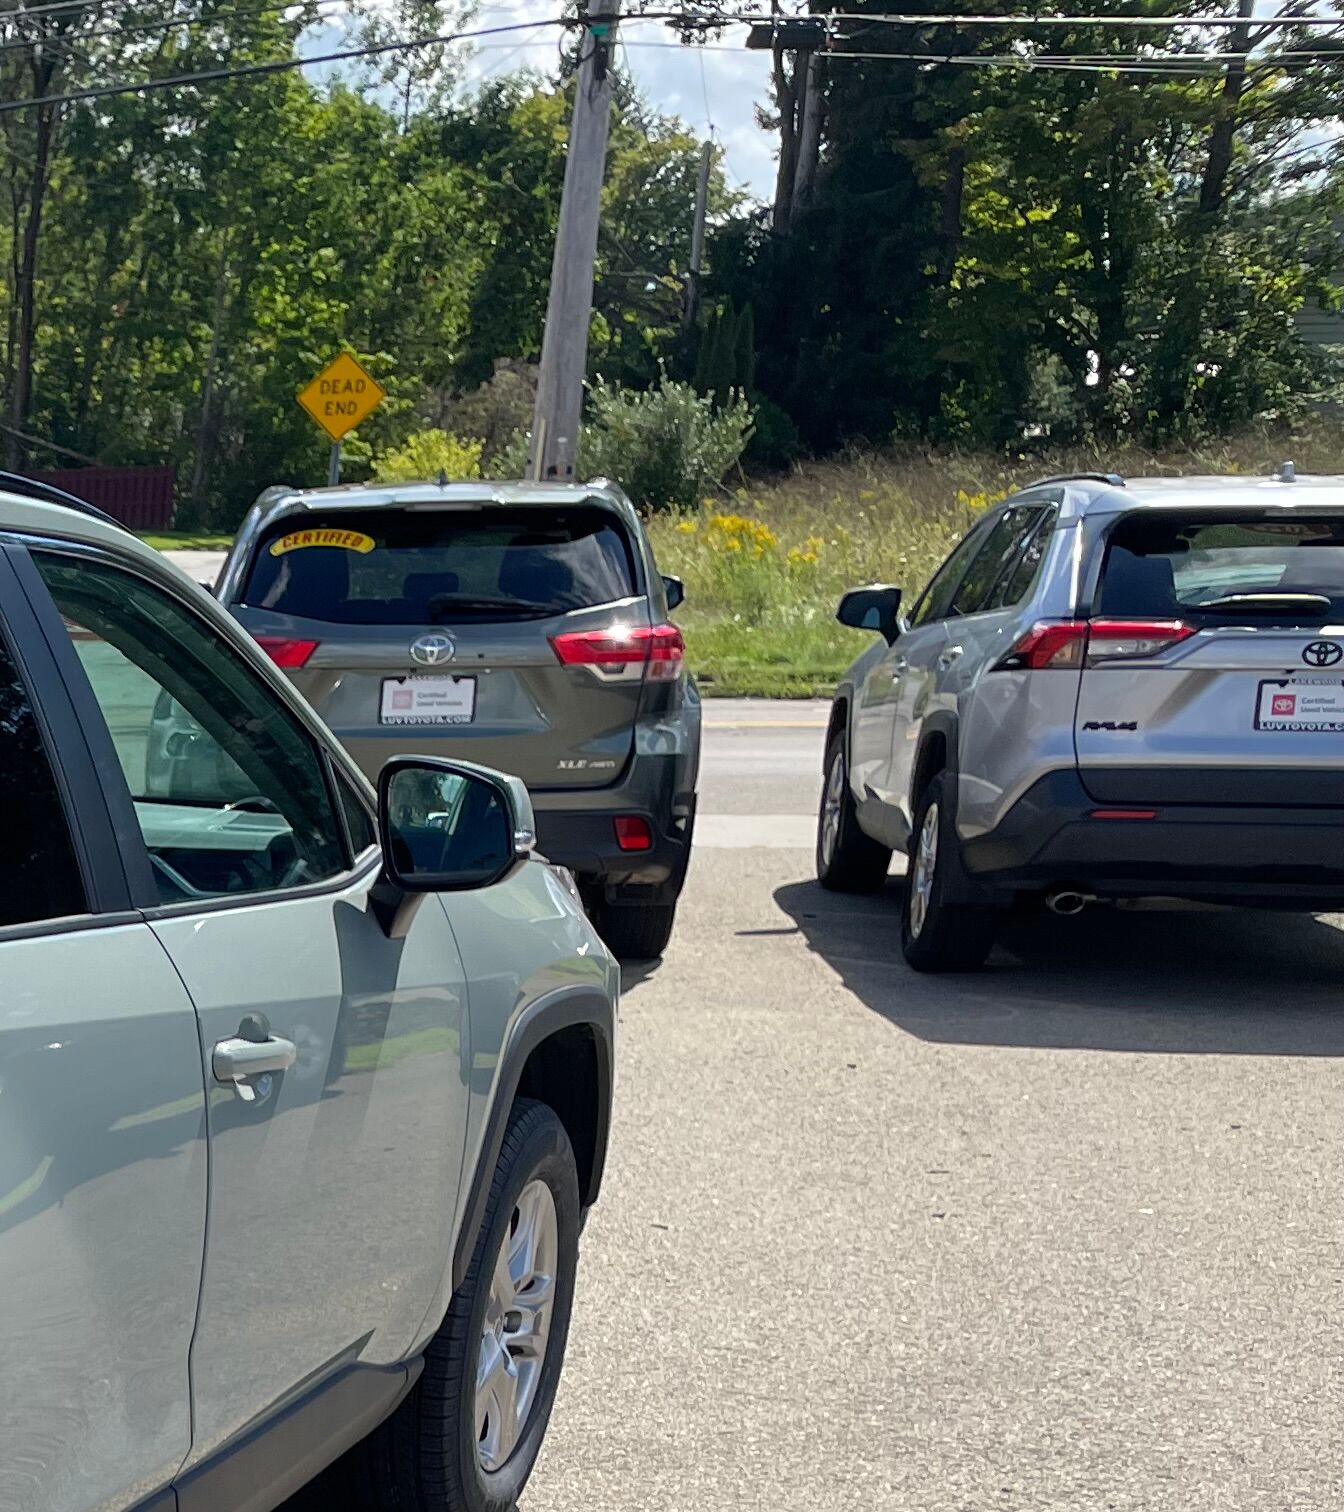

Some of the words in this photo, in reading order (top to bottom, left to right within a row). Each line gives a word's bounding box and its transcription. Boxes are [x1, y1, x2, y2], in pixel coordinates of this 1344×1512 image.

[319, 378, 367, 395] DEAD
[324, 401, 358, 416] END
[283, 530, 365, 548] CERTIFIED
[557, 760, 587, 769] XLE
